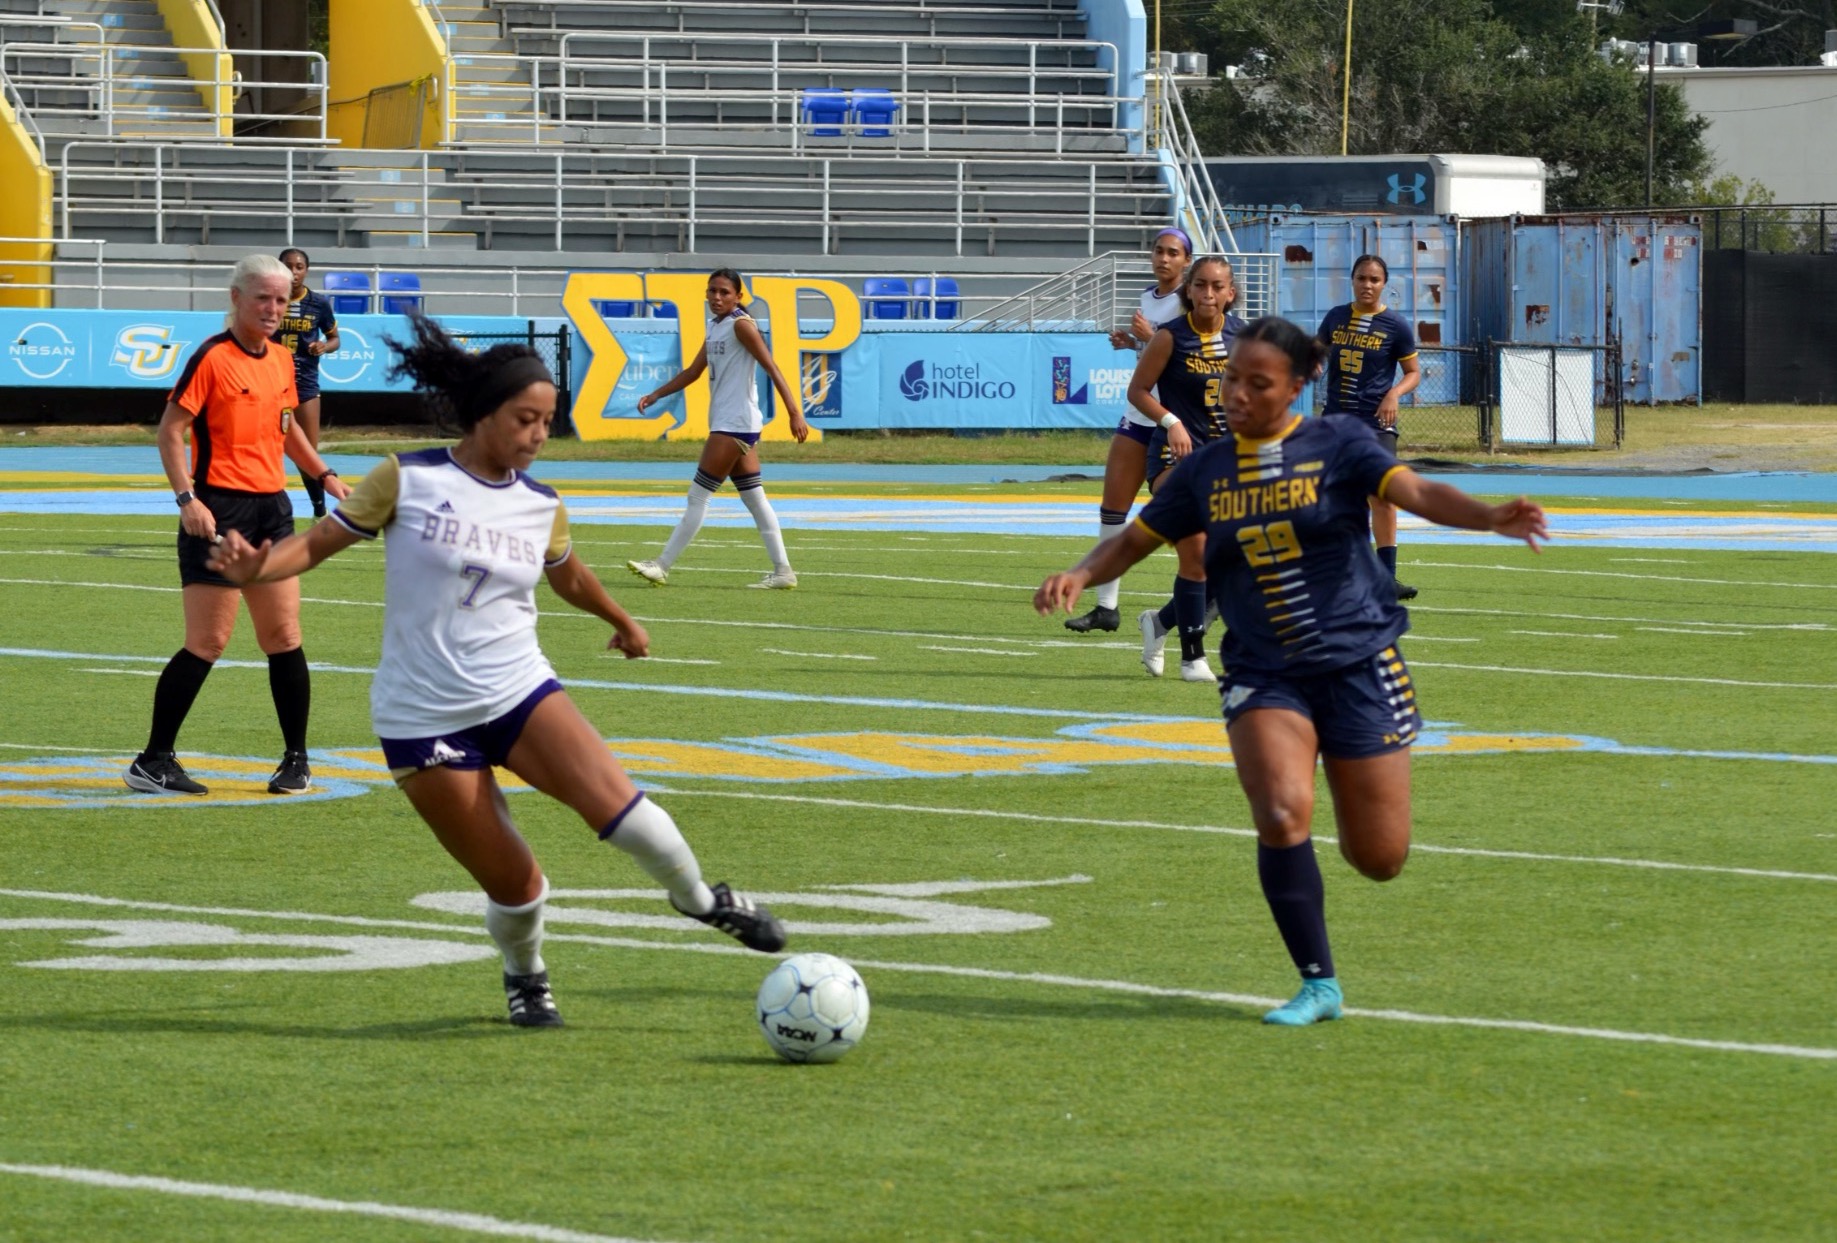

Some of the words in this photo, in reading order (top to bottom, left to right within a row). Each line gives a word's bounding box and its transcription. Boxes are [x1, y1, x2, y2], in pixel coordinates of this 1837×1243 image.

[9, 345, 75, 356] NISSAN
[1332, 330, 1384, 351] SOUTHERN
[932, 362, 980, 380] hotel
[1339, 348, 1364, 374] 25
[932, 381, 1016, 399] INDIGO
[1209, 476, 1320, 522] SOUTHERN
[420, 514, 537, 565] BRAVES
[1235, 519, 1304, 568] 29
[457, 559, 493, 611] 7
